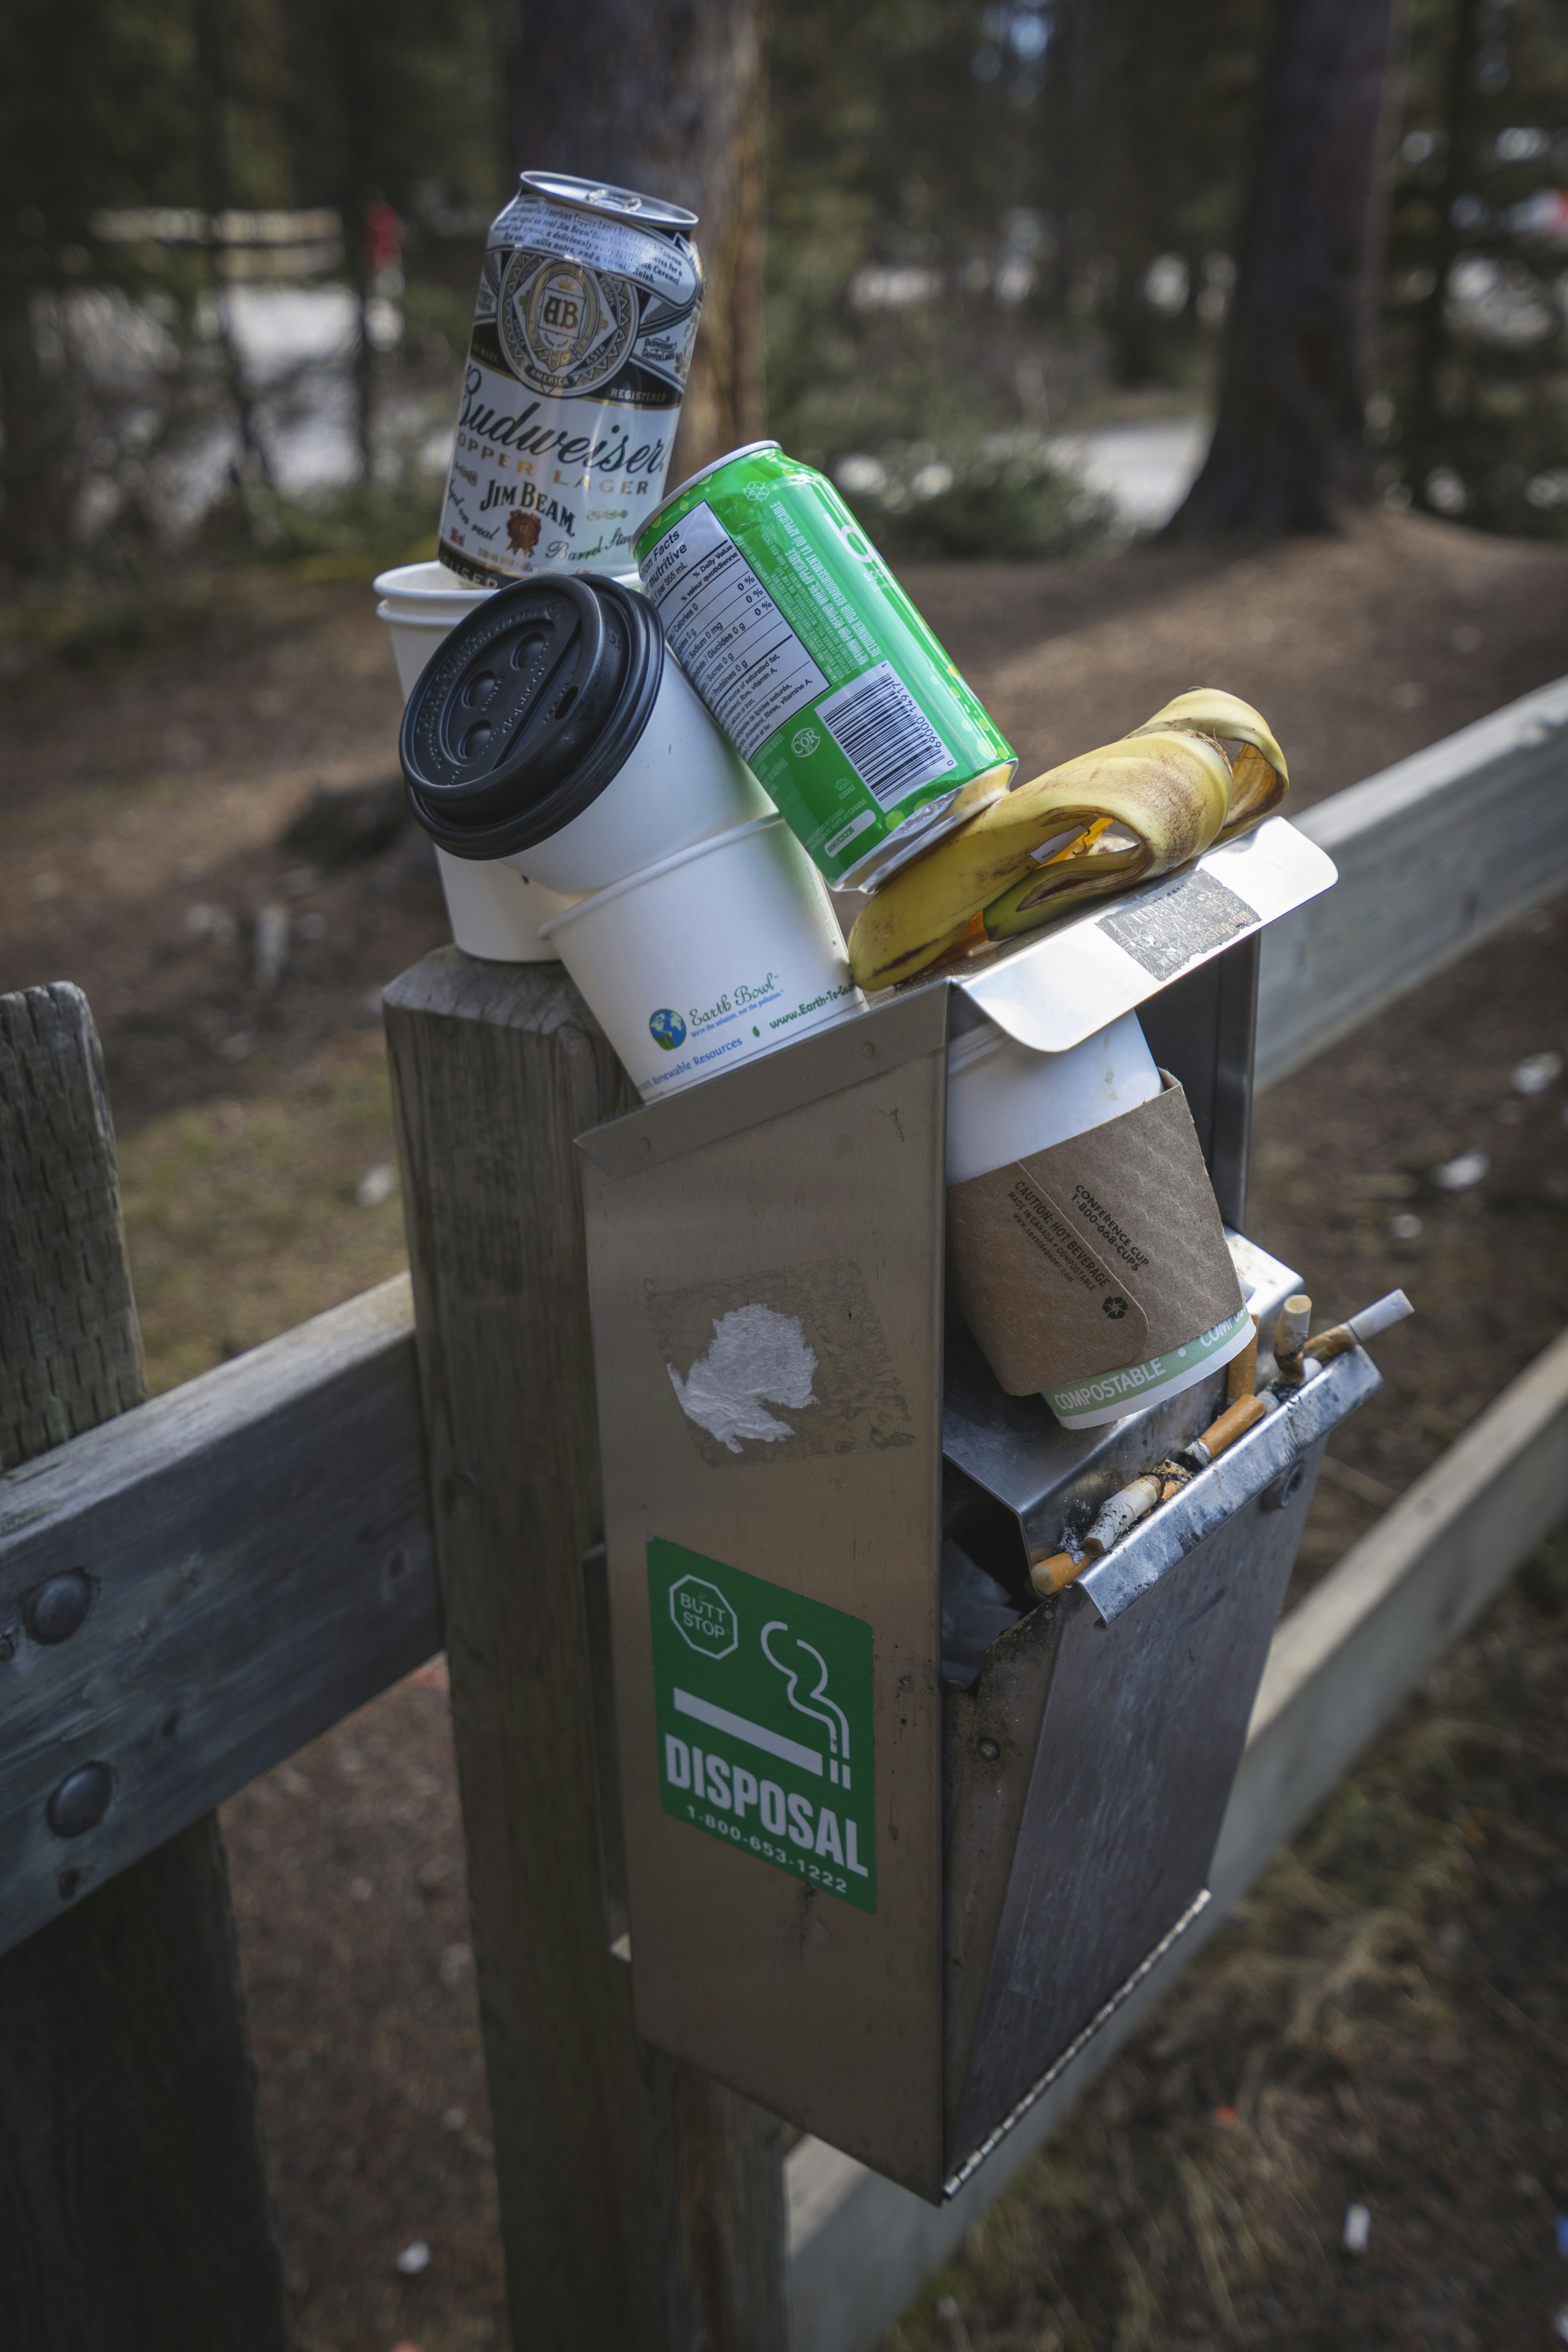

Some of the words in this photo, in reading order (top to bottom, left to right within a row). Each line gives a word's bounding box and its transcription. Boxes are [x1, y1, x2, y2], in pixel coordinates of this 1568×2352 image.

[552, 231, 593, 249] deliciously
[557, 222, 570, 230] Jim
[599, 221, 617, 234] Lager
[578, 249, 594, 260] and
[599, 277, 617, 307] EUROPE
[586, 345, 606, 365] ASIA
[530, 369, 569, 385] AMERICA
[610, 388, 666, 402] REGISTERED
[457, 433, 535, 477] OPPER
[554, 470, 648, 495] LAGER
[480, 479, 518, 512] JIM
[770, 501, 800, 537] APPLICABLE
[472, 524, 501, 541] real
[545, 536, 604, 561] Barrel
[651, 530, 680, 560] Facts
[791, 534, 807, 548] OÙ
[799, 545, 812, 557] LÀ
[647, 543, 688, 586] nutritive
[700, 558, 716, 572] Daily
[716, 544, 733, 559] Value
[785, 548, 815, 584] APPLICABLE
[664, 572, 676, 584] 355
[675, 561, 687, 573] mL
[687, 580, 703, 596] valeur
[703, 552, 737, 582] quotidienne
[744, 575, 754, 585] %
[782, 576, 791, 585] L4W
[806, 553, 847, 606] REMBOURSEMENT
[808, 583, 829, 605] WHERE
[673, 609, 693, 632] Calories
[689, 638, 707, 658] Sodium
[711, 622, 723, 634] mg
[753, 588, 764, 597] %
[822, 603, 845, 628] REFUND
[841, 604, 858, 622] POUR
[707, 632, 733, 658] Glucides
[755, 608, 761, 616] 0
[761, 601, 772, 610] %
[838, 626, 853, 641] FOR
[853, 621, 881, 656] RETOURNER
[823, 636, 837, 653] CANADA
[838, 644, 857, 669] CONSUMER
[847, 639, 869, 664] RETURN
[707, 663, 723, 681] Sucres
[728, 688, 740, 701] source
[745, 661, 769, 684] saturated
[769, 653, 780, 663] fat,
[835, 654, 851, 673] PEPSICO
[713, 670, 736, 695] Protéines
[725, 700, 741, 719] cholesterol,
[741, 690, 752, 701] fibre,
[751, 673, 769, 690] vitamin
[891, 680, 918, 713] 14917
[730, 712, 741, 724] calcium
[745, 699, 755, 708] iron.
[745, 717, 765, 738] cholestérol,
[765, 704, 780, 718] fibres,
[781, 683, 804, 704] vitamine
[754, 701, 769, 715] lipides
[770, 682, 791, 702] saturés,
[749, 734, 760, 748] calcium
[791, 728, 820, 755] COR
[915, 715, 942, 750] 69000
[829, 808, 844, 822] CANADA
[848, 799, 867, 815] CANADA
[690, 995, 732, 1026] Earth
[691, 1027, 705, 1037] We're
[715, 1012, 738, 1026] solution,
[652, 1060, 691, 1085] Renewable
[693, 1038, 742, 1065] Resources
[770, 982, 854, 1028] www.Earth-To-Go.
[1015, 1181, 1053, 1223] CAUTION:
[1051, 1222, 1070, 1241] HOT
[1067, 1241, 1109, 1287] BEVERAGE
[1071, 1194, 1140, 1270] 1-800-668-CUPS
[1075, 1184, 1130, 1245] CONFERENCE
[1131, 1247, 1149, 1265] CUP
[1008, 1192, 1025, 1210] MADE
[1031, 1218, 1053, 1242] CANADA
[1057, 1248, 1095, 1291] COMPOSTABLE
[1013, 1214, 1073, 1282] www.seasidepaper.com
[1054, 1356, 1166, 1410] COMPOSTABLE
[1200, 1308, 1246, 1347] COMPOS
[680, 1592, 726, 1623] BUTT
[683, 1612, 726, 1639] STOP
[664, 1733, 869, 1877] DISPOSAL
[687, 1805, 848, 1893] 1-800-653-1222
